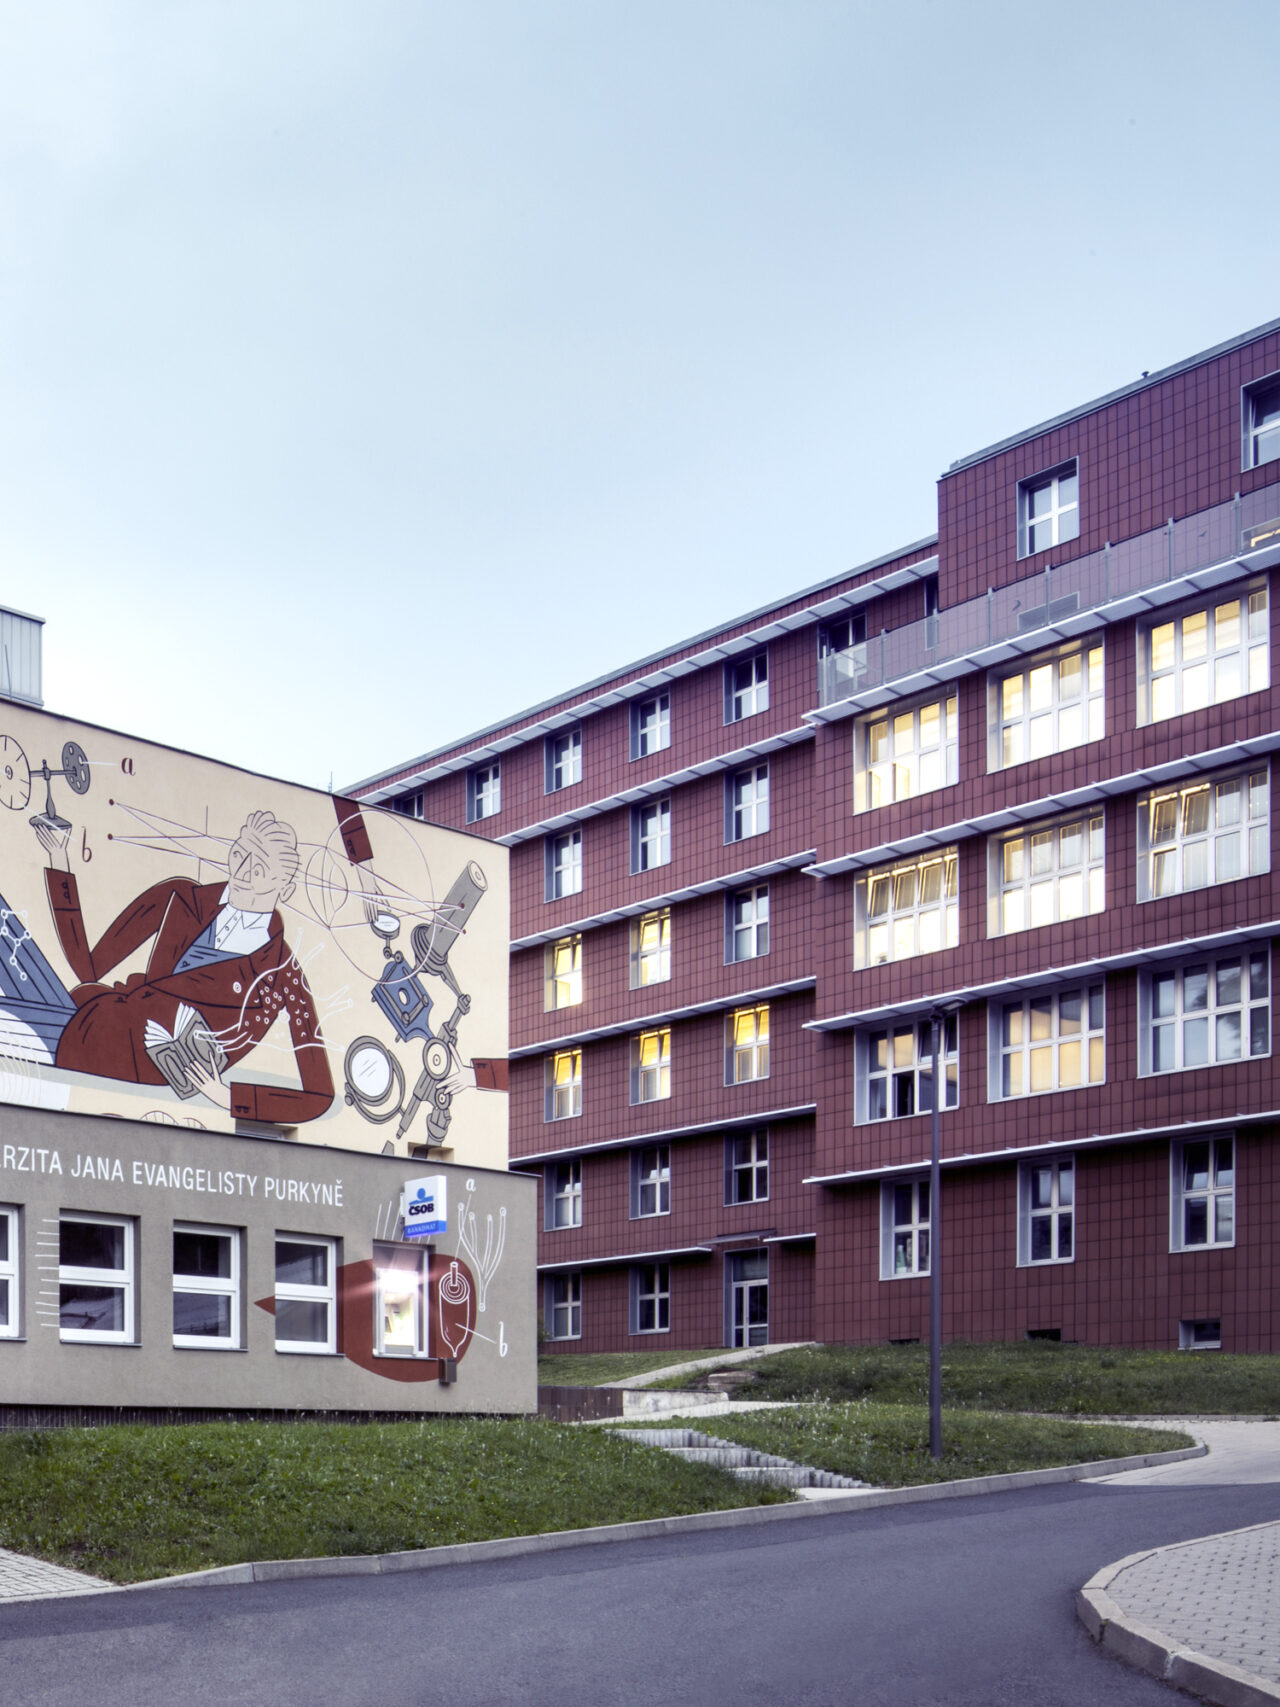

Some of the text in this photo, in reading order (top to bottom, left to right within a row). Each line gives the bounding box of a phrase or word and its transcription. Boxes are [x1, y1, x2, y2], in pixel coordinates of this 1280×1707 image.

[121, 757, 136, 776] a
[81, 826, 92, 863] b
[71, 1154, 124, 1182] JANA
[132, 1161, 258, 1197] EVANGELISTY
[264, 1177, 344, 1207] PURKYNĚ
